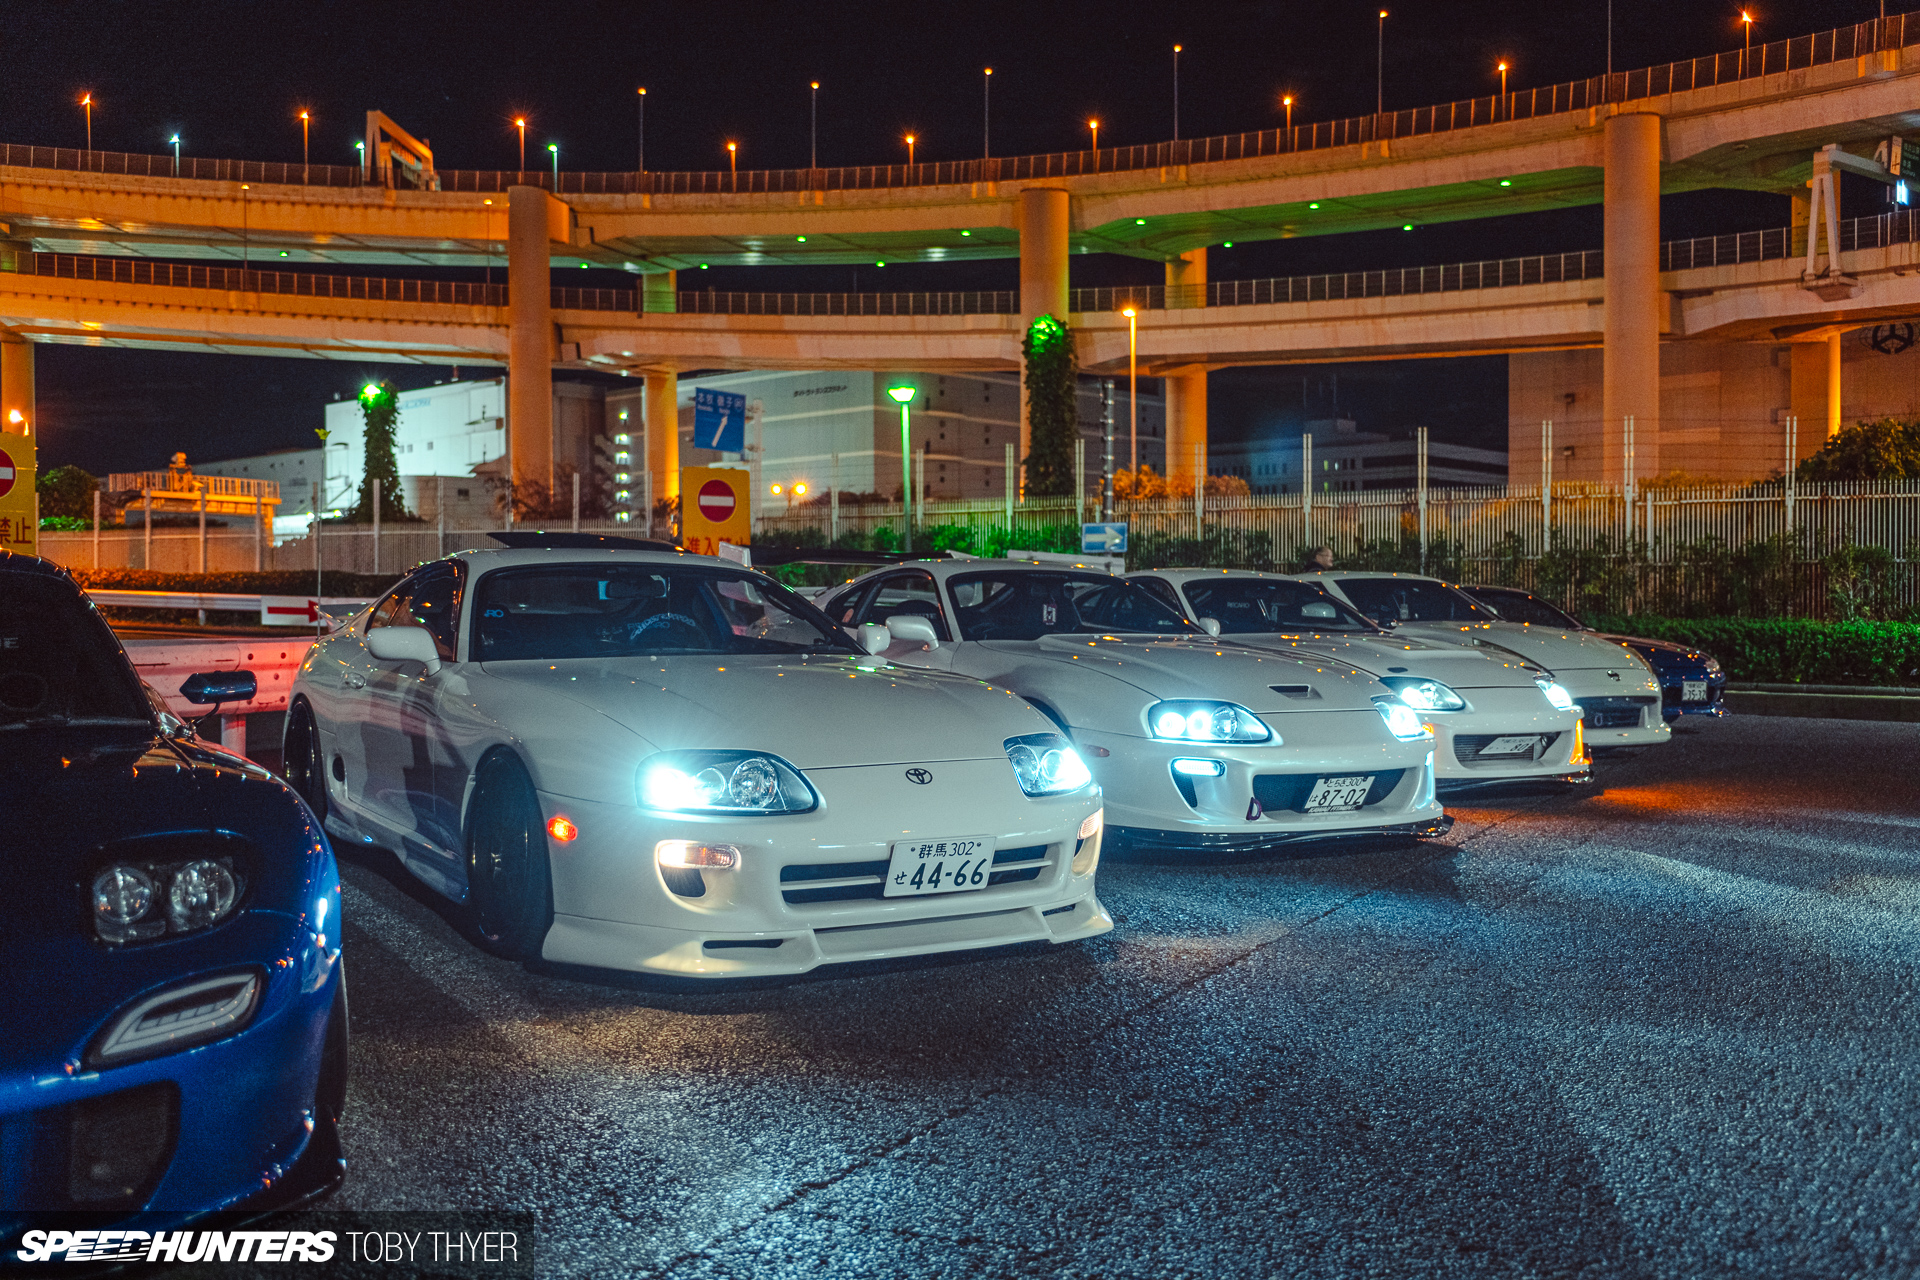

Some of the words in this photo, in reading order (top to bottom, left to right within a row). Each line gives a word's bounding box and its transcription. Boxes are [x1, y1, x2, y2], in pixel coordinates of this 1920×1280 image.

[1318, 788, 1367, 806] 87-02
[894, 871, 908, 885] せ
[909, 858, 988, 890] 44-66
